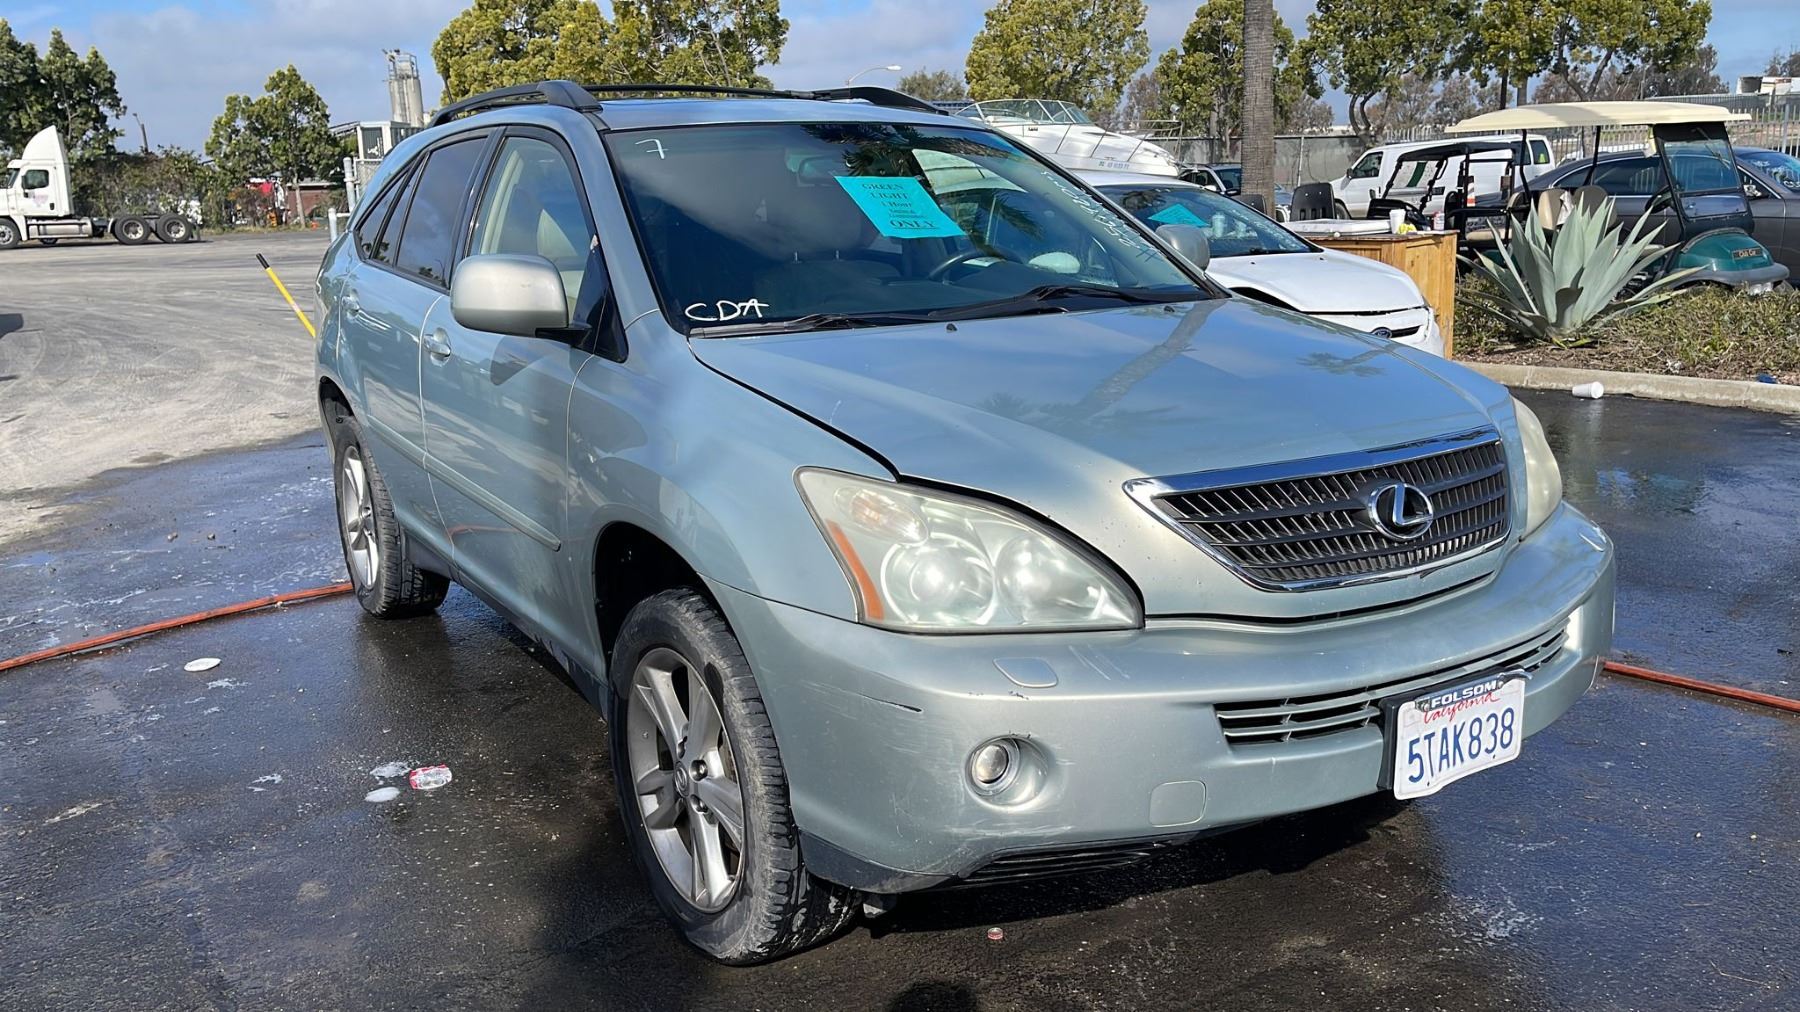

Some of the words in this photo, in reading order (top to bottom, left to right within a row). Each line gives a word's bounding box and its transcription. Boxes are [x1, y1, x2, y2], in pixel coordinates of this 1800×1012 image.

[635, 138, 669, 160] 7
[889, 220, 935, 228] ONLY
[685, 298, 769, 321] CDA
[1431, 680, 1497, 708] FOLSOM
[1408, 707, 1515, 783] 5TAK838
